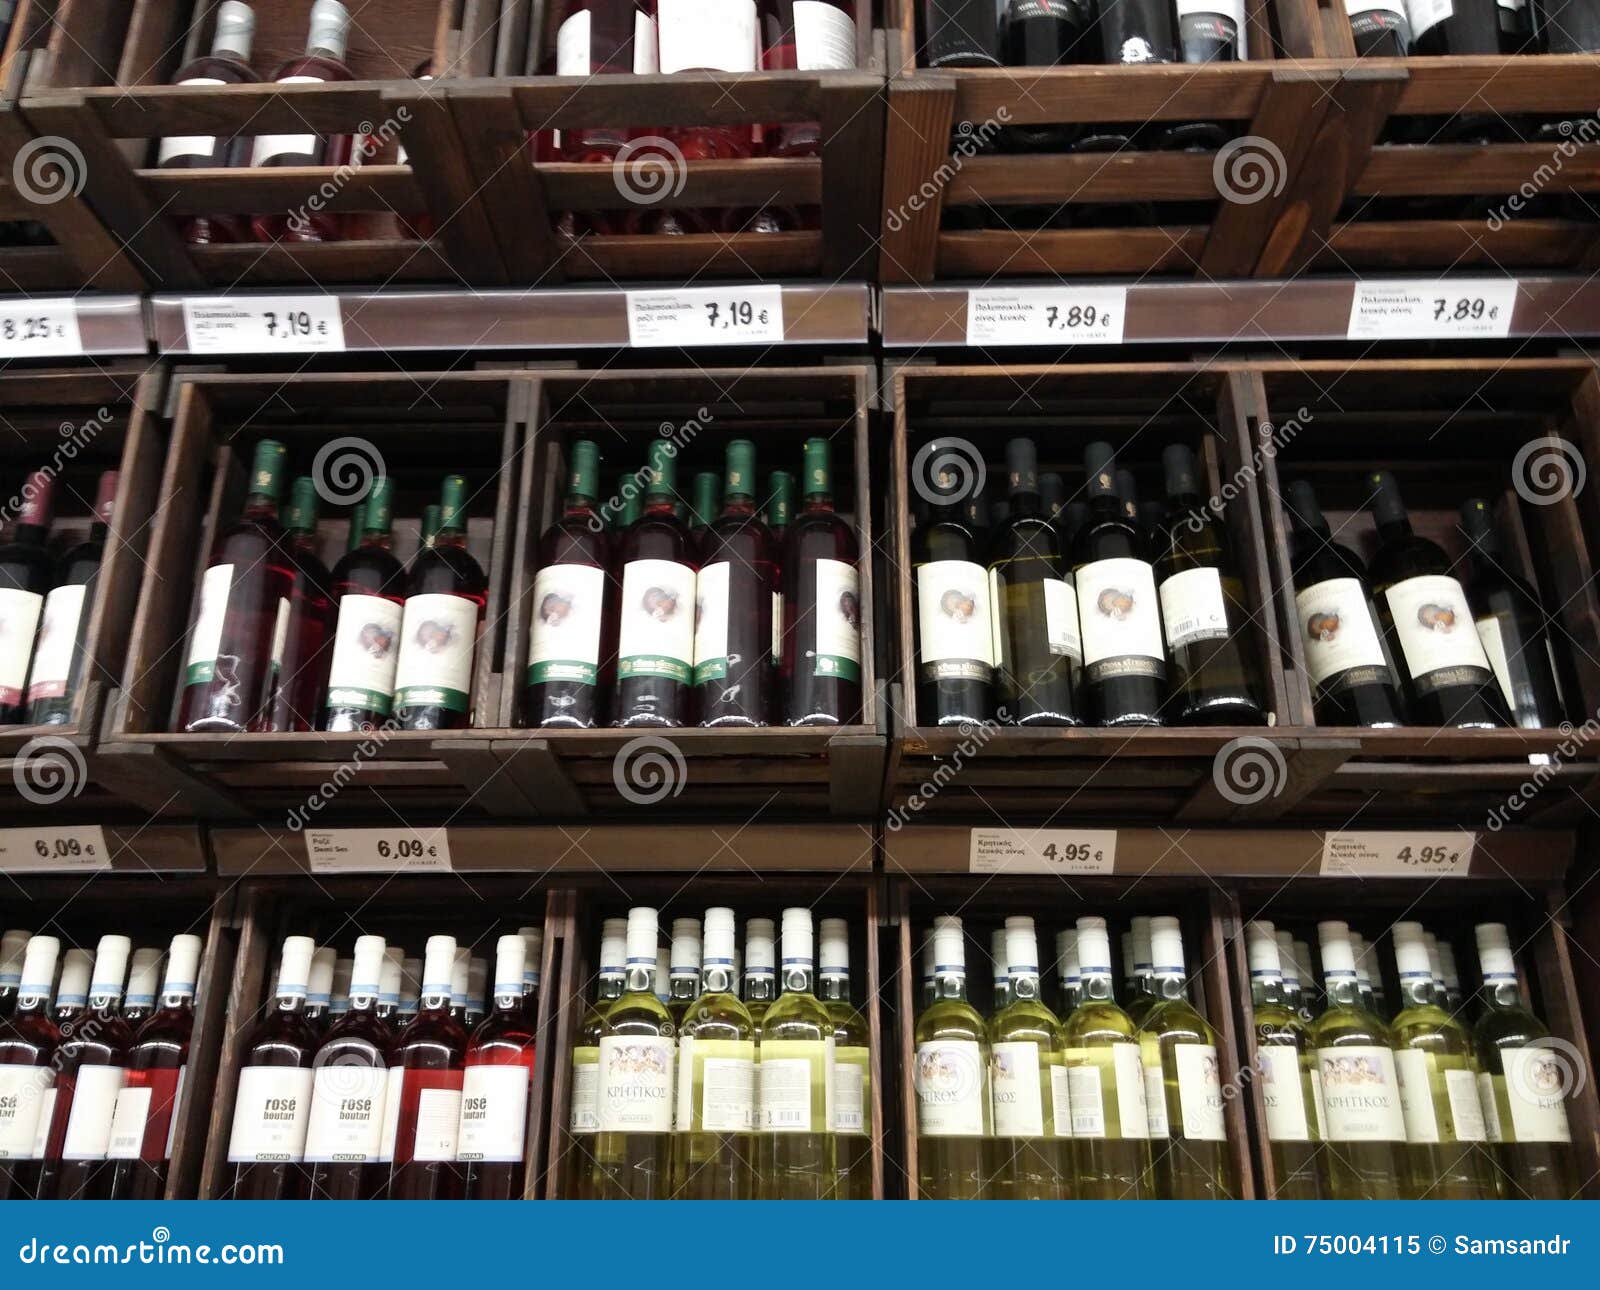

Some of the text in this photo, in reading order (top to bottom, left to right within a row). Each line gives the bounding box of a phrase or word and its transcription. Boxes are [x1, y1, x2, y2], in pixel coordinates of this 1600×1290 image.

[705, 301, 753, 329] 7,19
[1046, 305, 1096, 330] 7,89
[1433, 298, 1486, 323] 7,89
[2, 316, 50, 341] 8,25
[263, 311, 311, 338] 7,19
[35, 838, 81, 859] 6,09
[377, 840, 424, 860] 6,09
[1042, 843, 1091, 862] 4,95
[1397, 846, 1447, 865] 4,95
[264, 1096, 297, 1111] rosé
[341, 1096, 372, 1111] rosé
[263, 1110, 295, 1121] boutari
[339, 1110, 371, 1121] boutari
